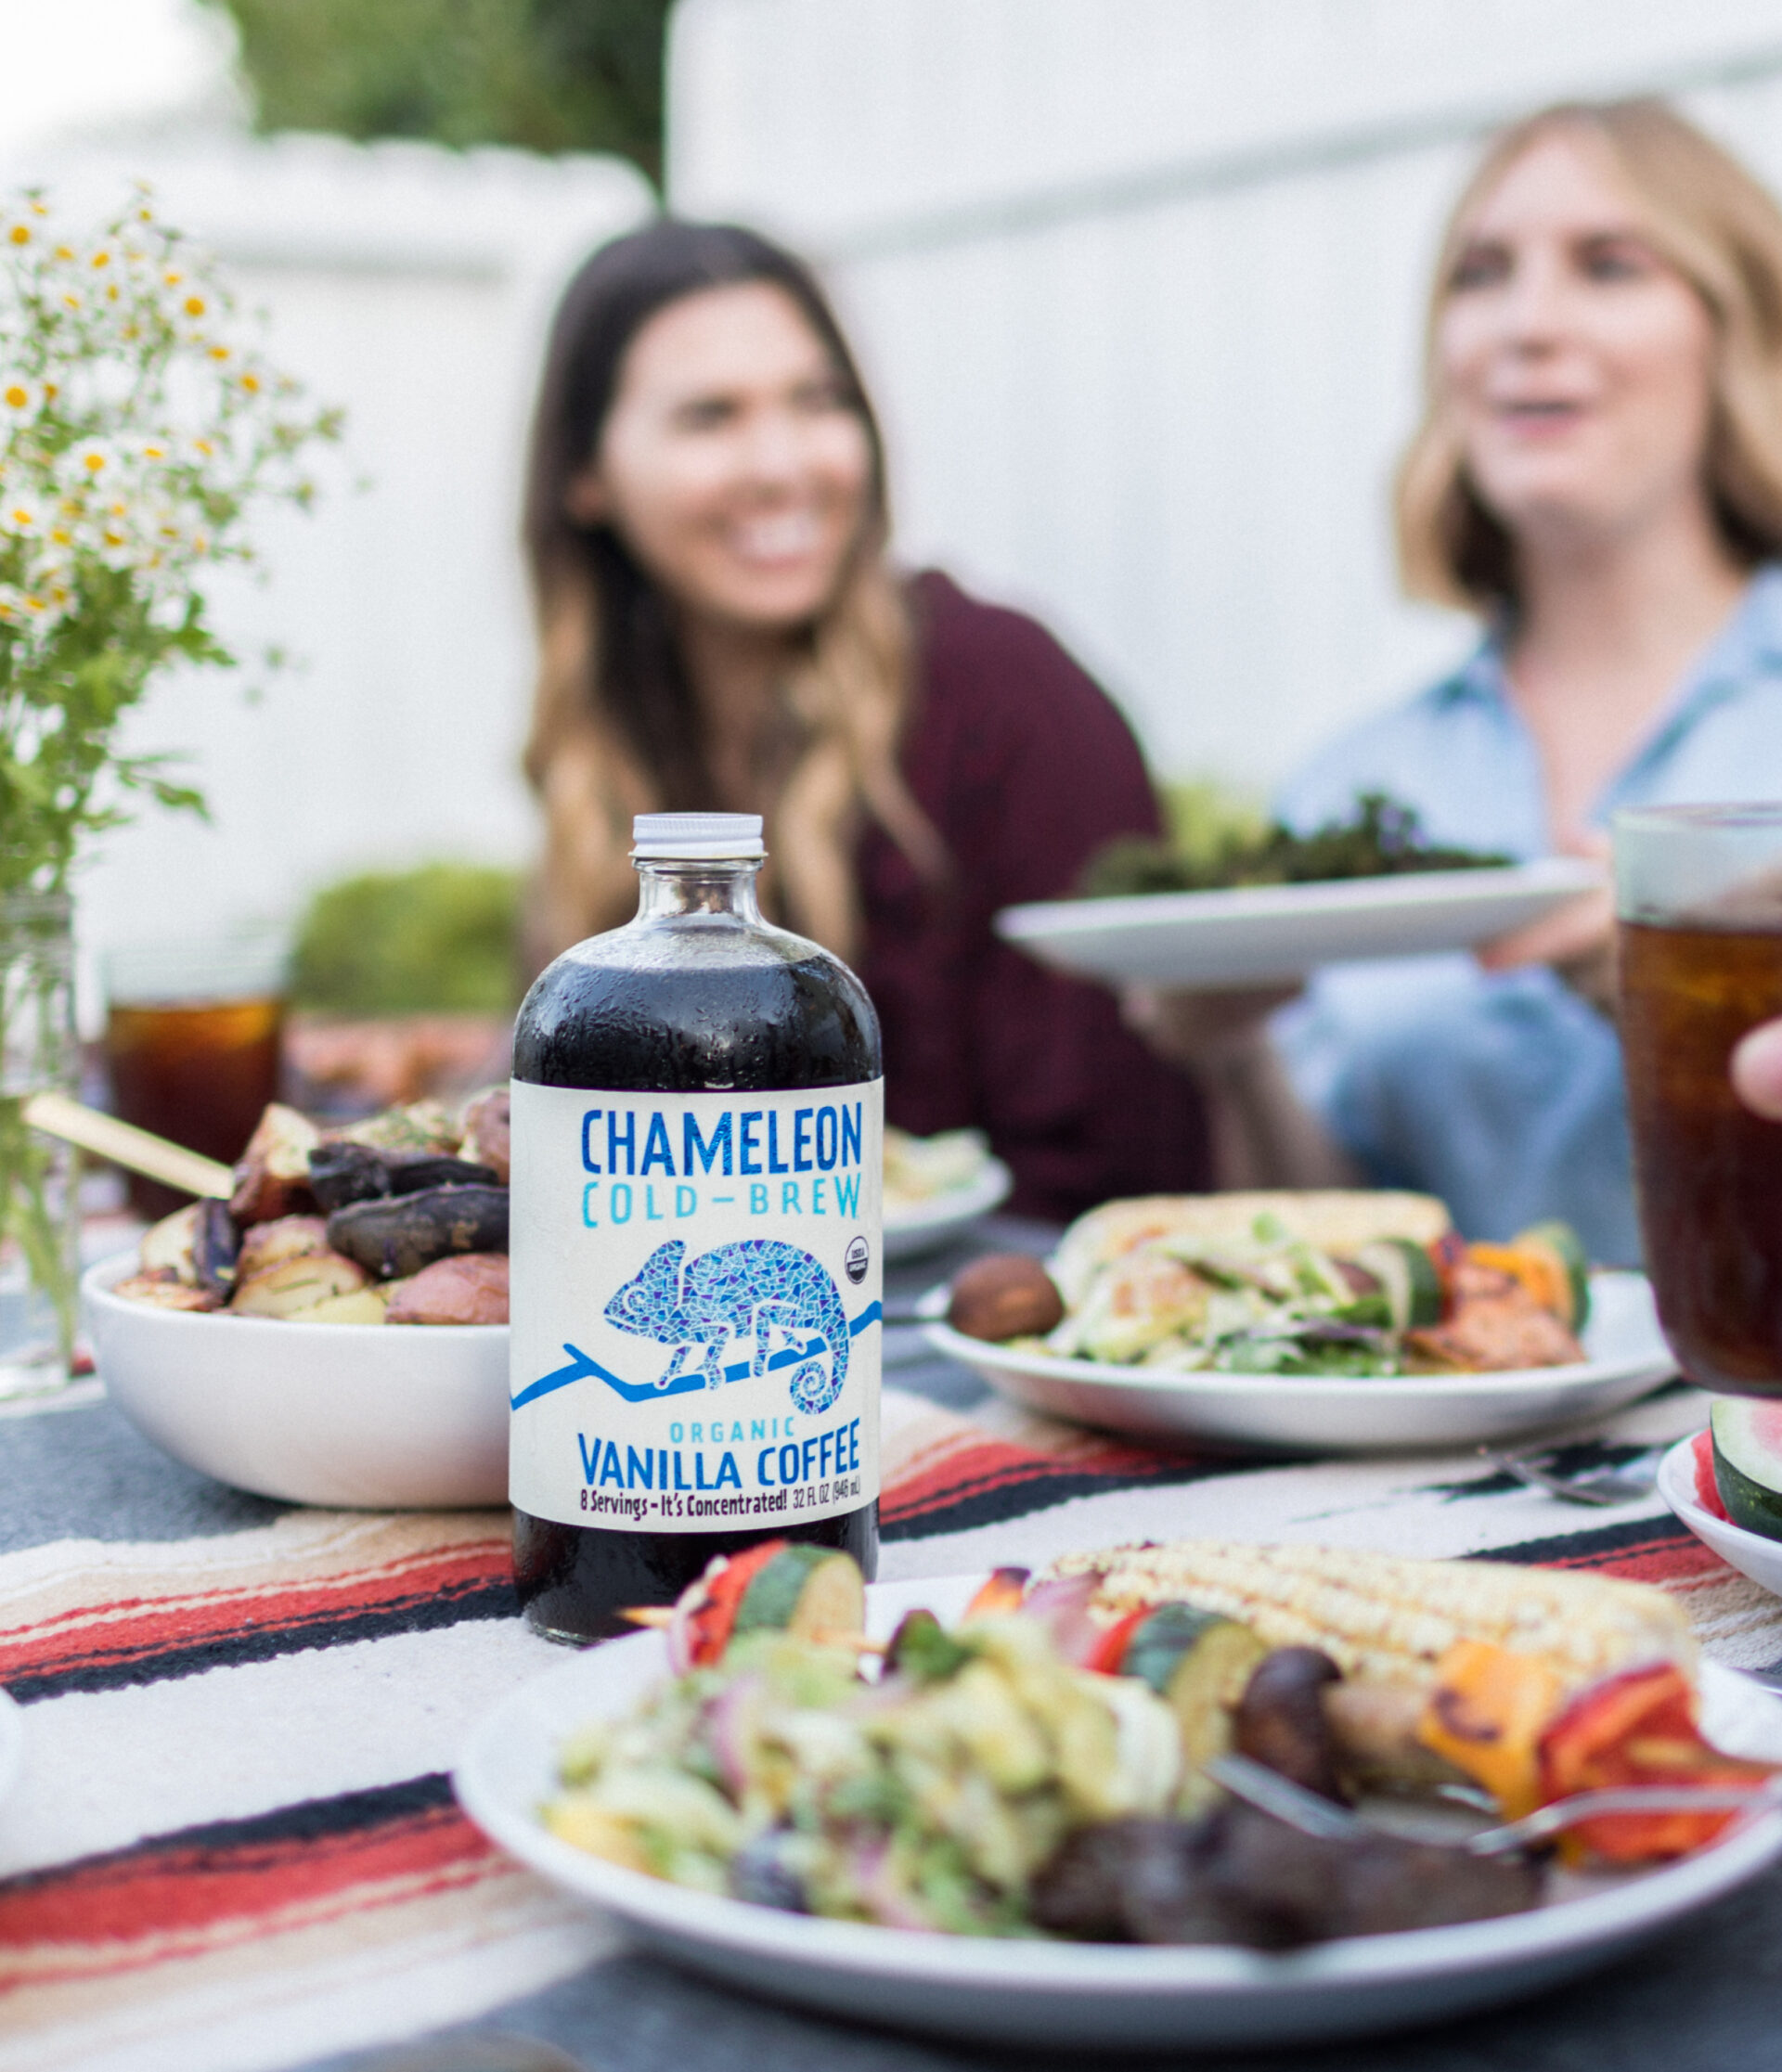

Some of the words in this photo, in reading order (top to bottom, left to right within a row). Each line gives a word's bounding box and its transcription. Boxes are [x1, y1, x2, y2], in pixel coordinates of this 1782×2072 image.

[581, 1102, 862, 1176] CHAMELEON
[670, 1417, 794, 1443] ORGANIC
[577, 1433, 742, 1490] VANILLA
[758, 1418, 859, 1486] COFFEE
[580, 1489, 588, 1504] 8
[591, 1491, 648, 1521] Servings
[661, 1493, 683, 1516] It's
[687, 1490, 786, 1516] Concentrated!
[793, 1489, 805, 1509] 32
[820, 1484, 830, 1503] OZ
